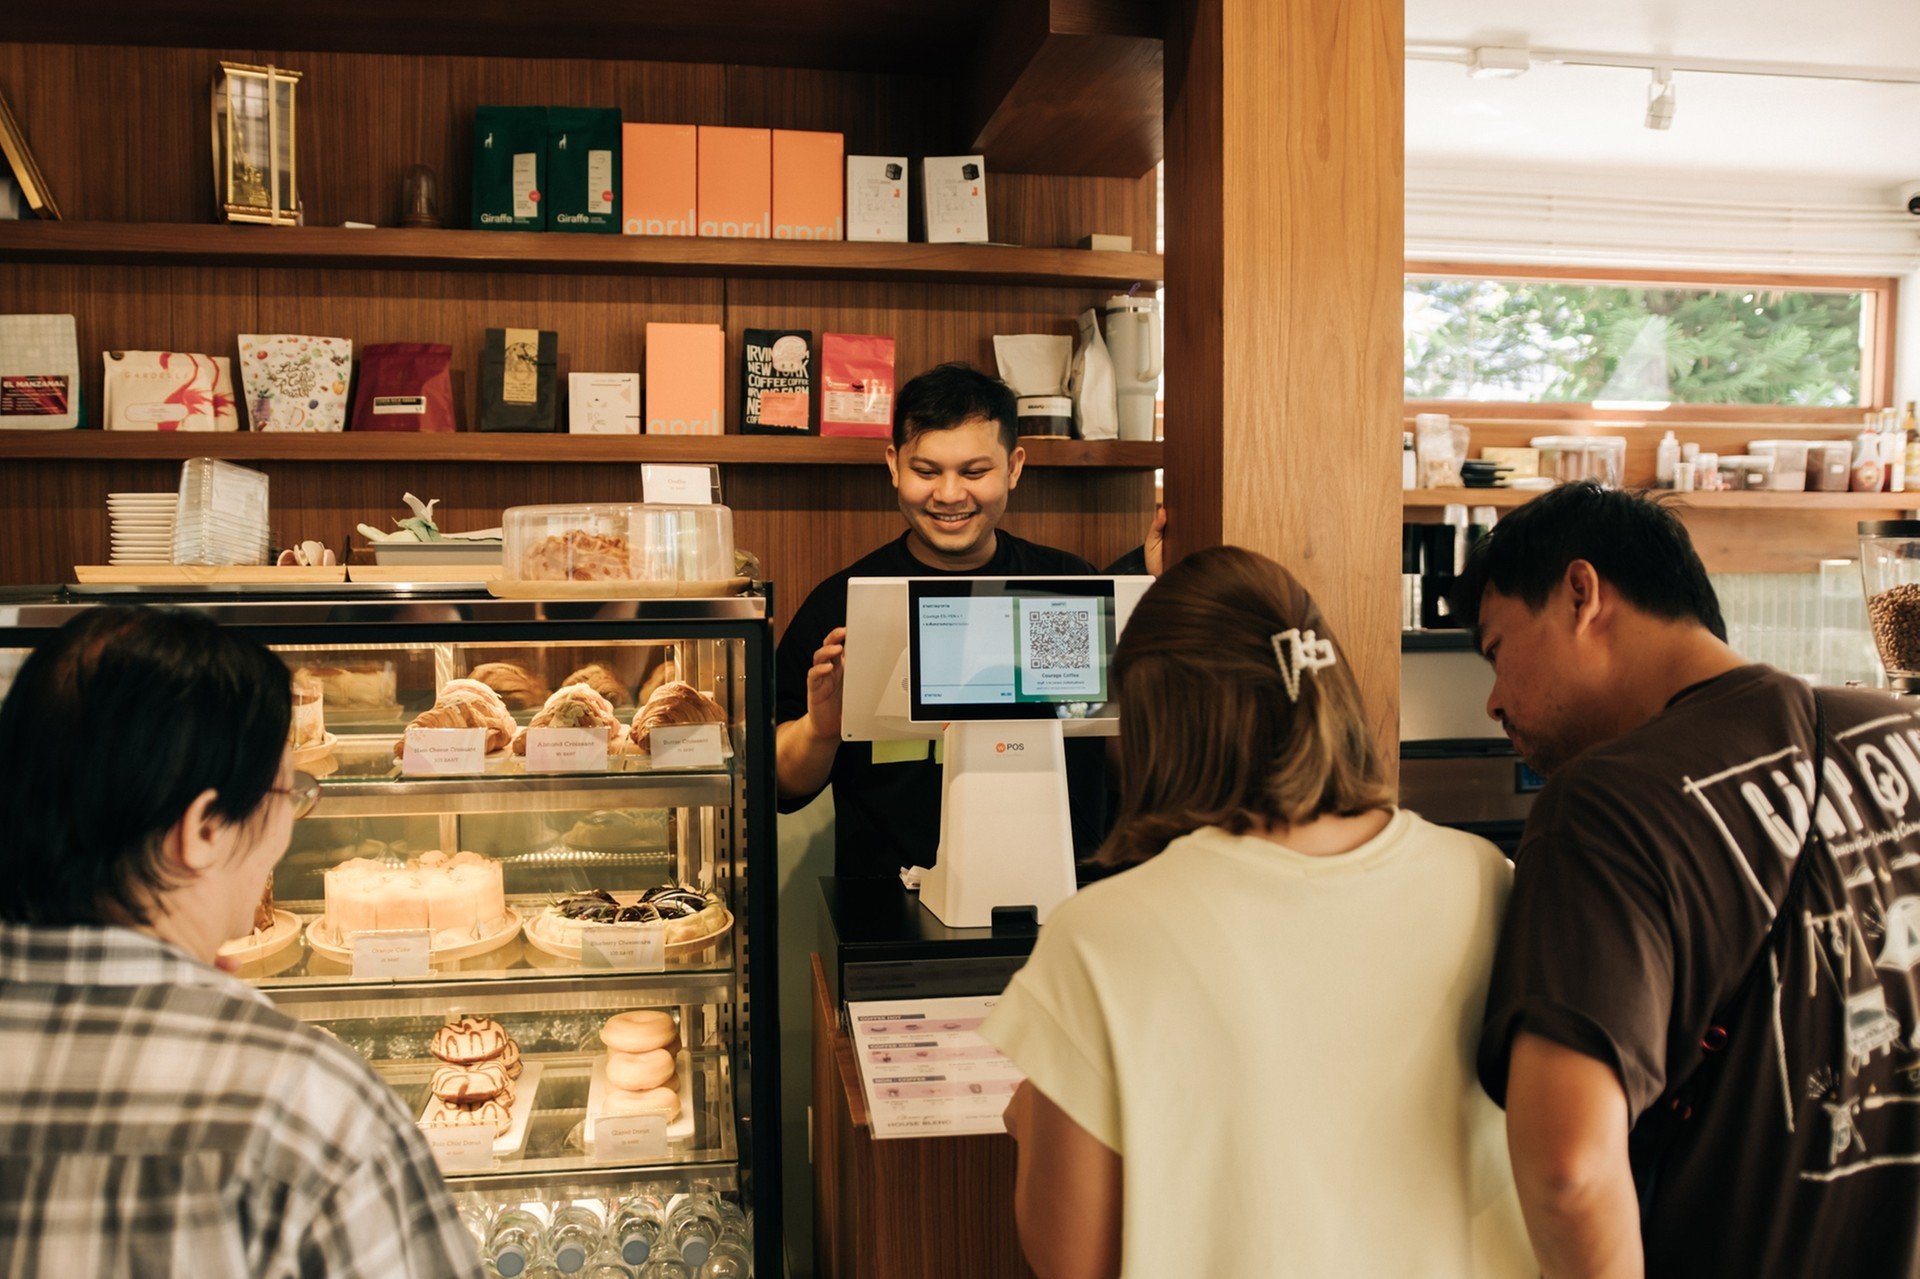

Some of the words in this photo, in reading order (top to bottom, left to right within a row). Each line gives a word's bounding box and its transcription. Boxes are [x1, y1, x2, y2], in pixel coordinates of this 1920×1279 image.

[480, 213, 513, 223] Giraffe
[557, 213, 589, 224] Giraffe
[623, 208, 695, 236] april
[700, 211, 770, 239] april
[774, 215, 843, 241] april
[747, 361, 772, 377] NEW
[15, 380, 66, 388] MANZANAL
[748, 374, 788, 388] COFFEE
[747, 397, 761, 415] NE
[649, 407, 719, 435] april
[1006, 743, 1025, 751] POS
